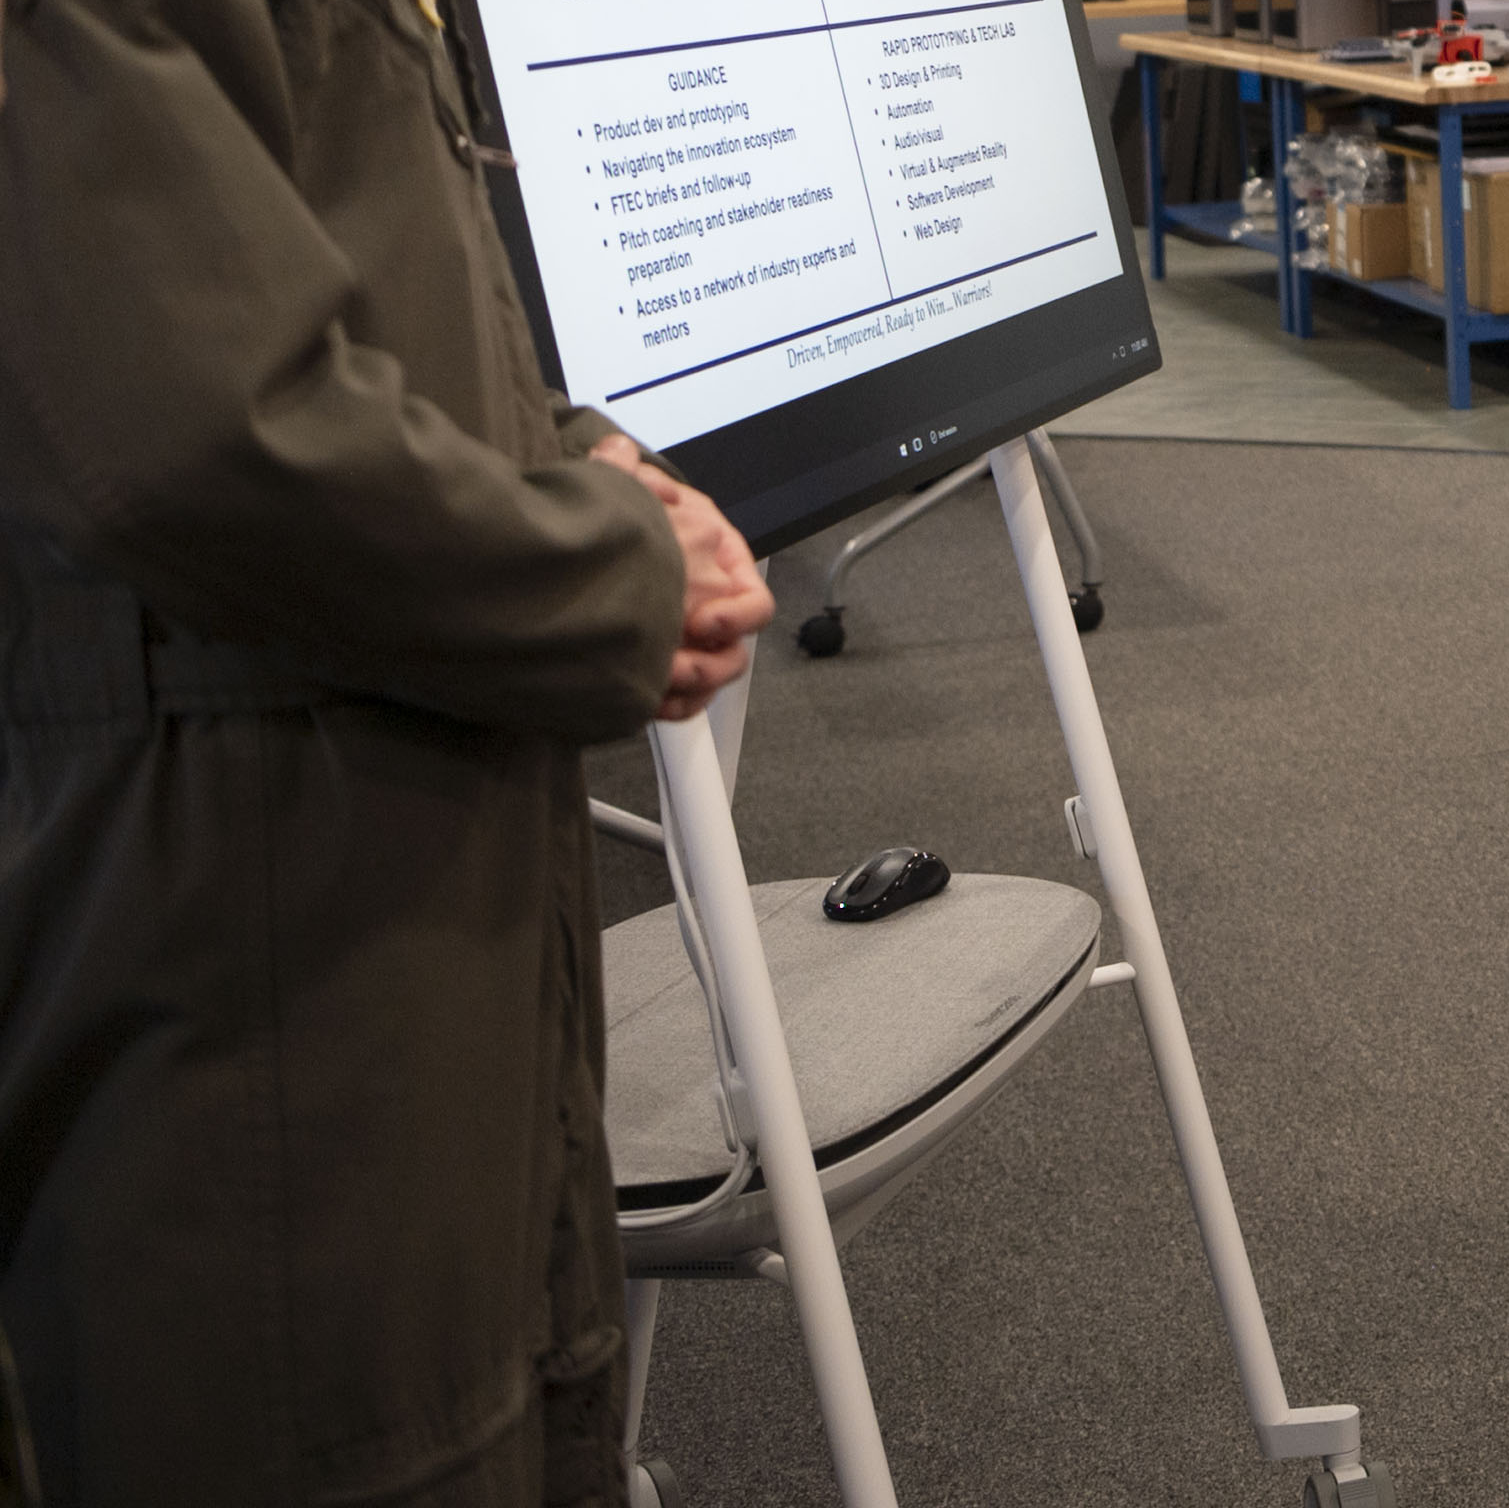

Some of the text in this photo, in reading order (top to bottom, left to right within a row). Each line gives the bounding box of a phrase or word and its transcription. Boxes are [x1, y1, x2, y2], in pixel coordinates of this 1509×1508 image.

[882, 22, 1016, 57] RAPID PROTOTYPING & TECH LAB
[668, 65, 728, 92] GUIDANCE
[879, 62, 963, 90] 3D Design & Printing
[593, 100, 750, 142] Product dev and prototyping
[887, 98, 934, 120] Automation
[602, 127, 796, 179] Navigating the innovation ecosystem
[899, 142, 1007, 180] Virtual & Augmented Reality
[610, 171, 752, 215] FTEC briefs and follow-up
[907, 175, 995, 211] Software Development
[619, 186, 834, 252] Pitch coaching and stakeholder readiness
[913, 216, 962, 241] Web Design
[627, 251, 693, 287] preparation
[636, 238, 856, 318] Access to a network of industry experts and
[642, 321, 690, 348] mentors
[885, 307, 914, 333] Ready
[916, 304, 926, 322] to
